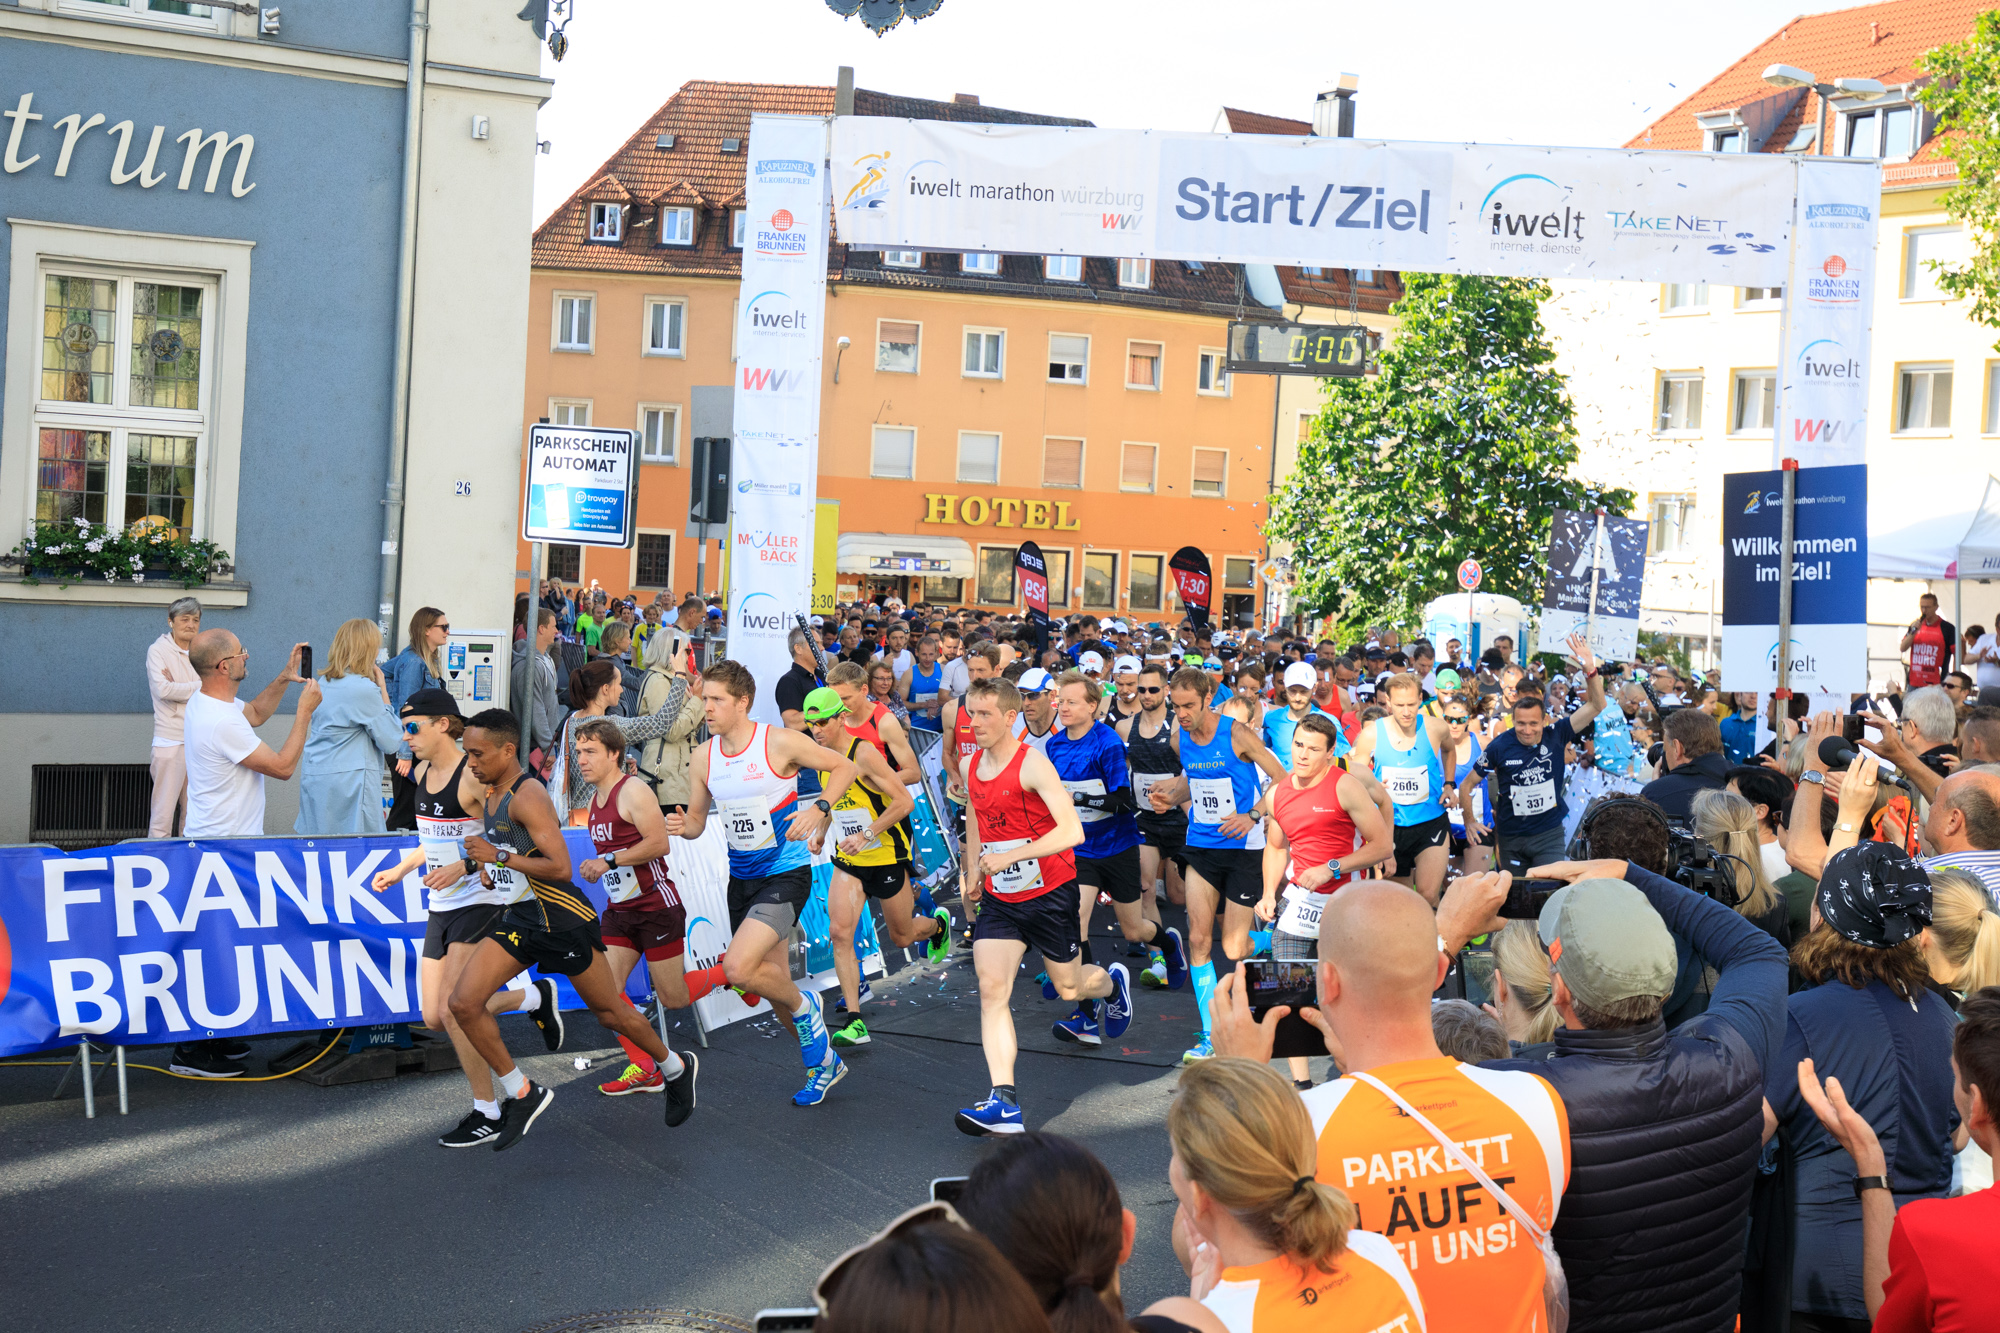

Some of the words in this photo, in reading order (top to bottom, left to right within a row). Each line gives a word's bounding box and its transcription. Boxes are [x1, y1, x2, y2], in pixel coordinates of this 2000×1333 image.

[3, 92, 257, 198] trum
[761, 161, 811, 174] KAPUZINER
[758, 177, 810, 185] ALKOHOLFREI
[909, 175, 962, 198] iwelt
[969, 178, 1054, 202] marathon
[1060, 185, 1144, 211] würzburg
[1175, 177, 1430, 232] Start/Ziel
[1811, 206, 1865, 218] KAPUZINER
[1491, 202, 1585, 240] iwelt
[1808, 221, 1865, 229] ALKOHOLFREI
[758, 231, 806, 242] FRANKEN
[757, 241, 806, 251] BRUNNEN
[1809, 278, 1860, 288] FRANKEN
[1809, 288, 1859, 298] BRUNNEN
[753, 307, 807, 329] iwelt
[1287, 335, 1357, 363] 0:00
[1805, 356, 1860, 378] iwelt
[743, 367, 804, 392] WVV
[1794, 418, 1857, 443] WVV
[535, 435, 627, 454] PARKSCHEIN
[543, 456, 617, 473] AUTOMAT
[456, 480, 471, 495] 26
[1816, 495, 1846, 504] würzburg
[923, 493, 1081, 531] HOTEL
[738, 530, 798, 549] MÜLLER
[1731, 536, 1857, 556] Willkmmen
[760, 547, 797, 563] BÄCK
[1570, 525, 1620, 582] A
[1755, 563, 1780, 581] im
[1791, 560, 1831, 581] Ziel!
[1180, 576, 1205, 595] 1:30
[1609, 600, 1628, 609] 3:30
[743, 608, 793, 631] iwelt
[1913, 643, 1939, 656] WÜRZ
[1912, 655, 1936, 666] BURG
[1187, 760, 1226, 770] SPIRIDON
[1523, 773, 1546, 786] 42K
[1202, 796, 1219, 808] 479
[1526, 797, 1544, 809] 337
[590, 822, 613, 842] ASV
[732, 819, 755, 833] 225
[491, 869, 514, 884] 2462
[605, 871, 621, 886] 358
[42, 849, 431, 943] FRANKE
[50, 938, 424, 1037] BRUNN
[1342, 1133, 1513, 1188] PARKETT
[1432, 1218, 1517, 1264] UNS!
